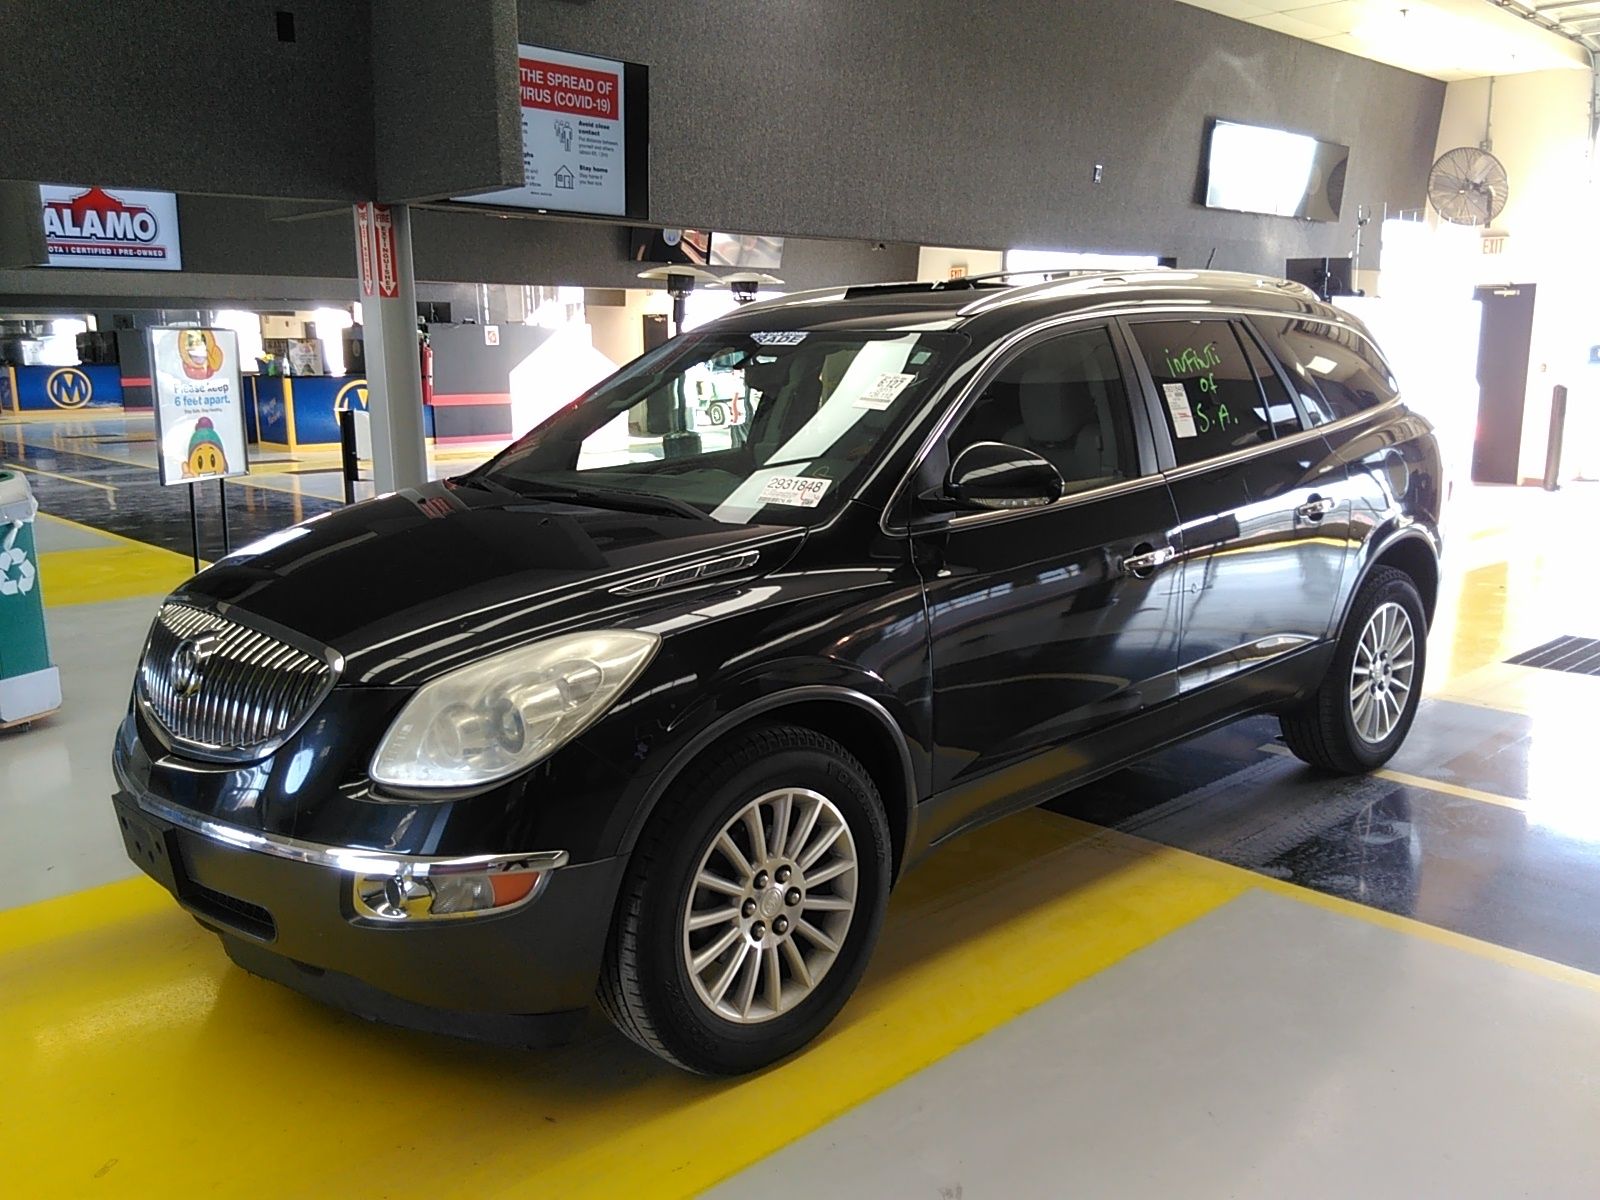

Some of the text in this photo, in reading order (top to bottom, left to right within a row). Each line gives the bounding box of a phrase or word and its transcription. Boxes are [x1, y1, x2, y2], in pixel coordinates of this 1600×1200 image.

[520, 67, 613, 95] THE SPREAD OF
[555, 90, 611, 114] (COVID-19)
[579, 120, 610, 130] Avoid close
[579, 129, 600, 137] contact
[579, 164, 591, 172] Stay
[43, 207, 157, 242] ALAMO
[375, 213, 390, 223] FIRE
[70, 246, 112, 255] CERTIFIED
[119, 248, 163, 257] PRE-OWNED
[1482, 238, 1505, 254] EXIT
[381, 226, 391, 291] EXTINGUISHER
[1200, 372, 1218, 394] of
[175, 395, 231, 407] 6 feet apart.
[767, 478, 823, 493] 2931848
